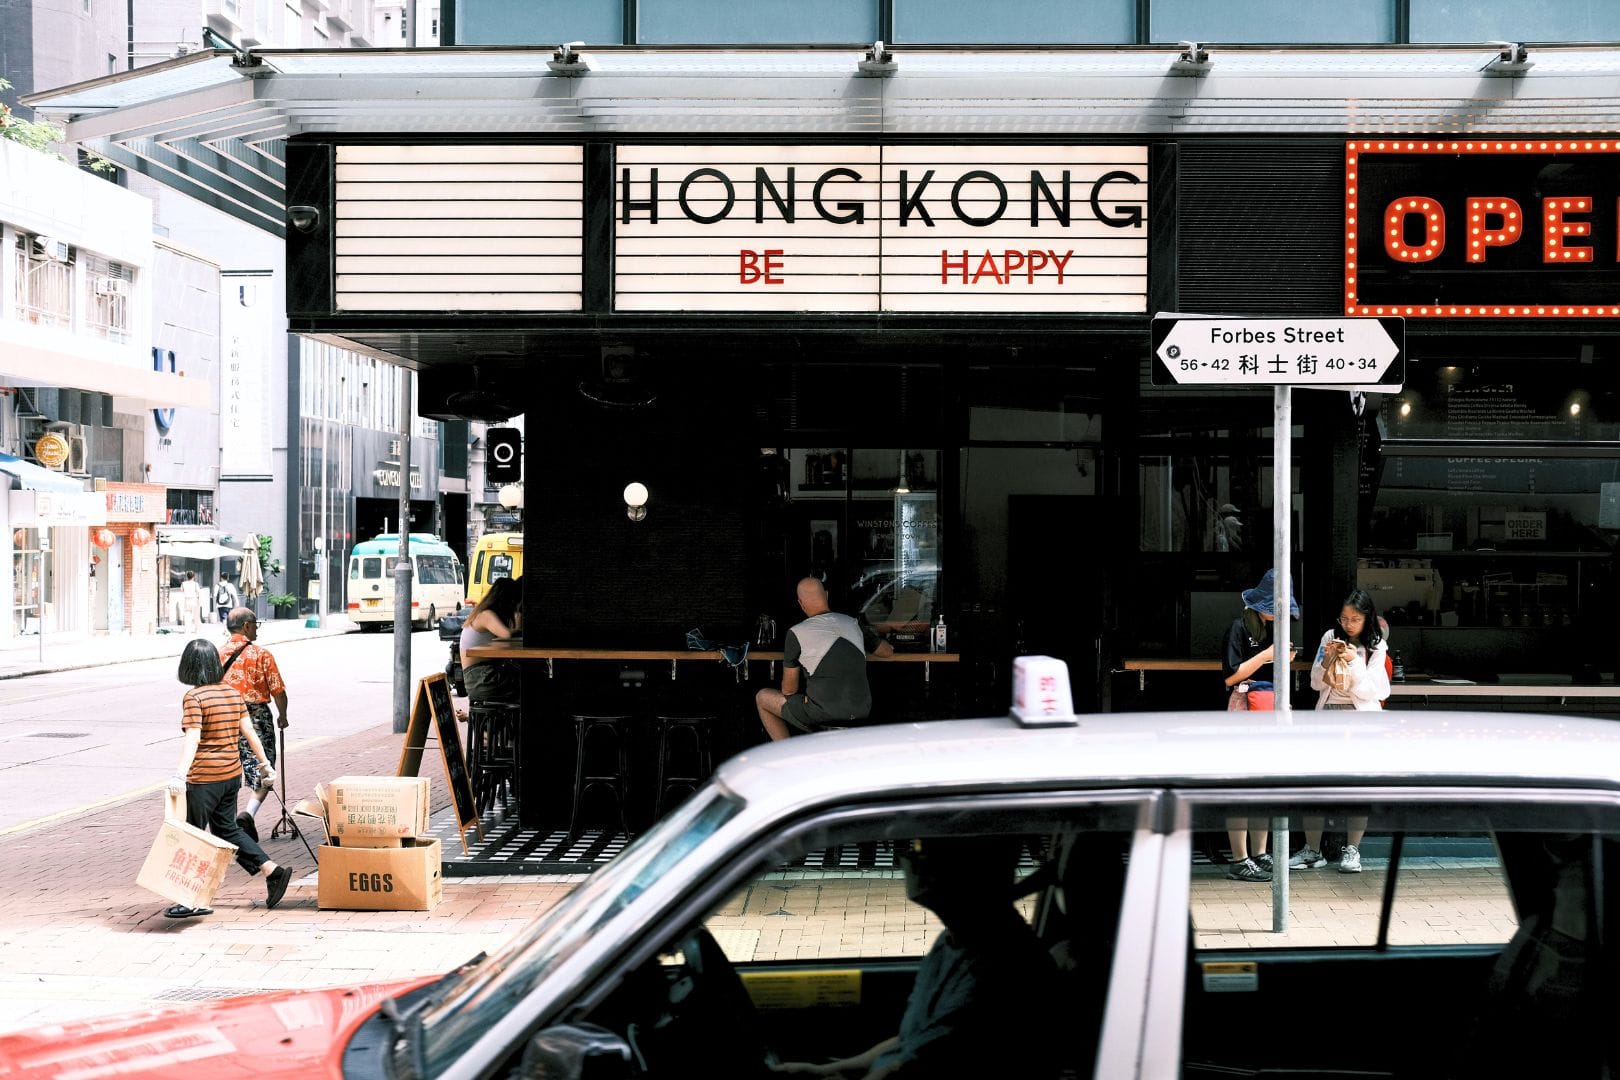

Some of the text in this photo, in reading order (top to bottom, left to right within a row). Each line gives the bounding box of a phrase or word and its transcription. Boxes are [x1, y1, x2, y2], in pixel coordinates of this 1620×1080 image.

[621, 167, 1143, 228] HONG KONG
[1383, 195, 1620, 263] OPE
[739, 249, 1074, 285] BE HAPPY
[1211, 327, 1344, 343] Forbes Street
[1238, 353, 1318, 375] 科士街
[1508, 519, 1543, 537] ORDER HERE
[349, 873, 394, 893] EGGS
